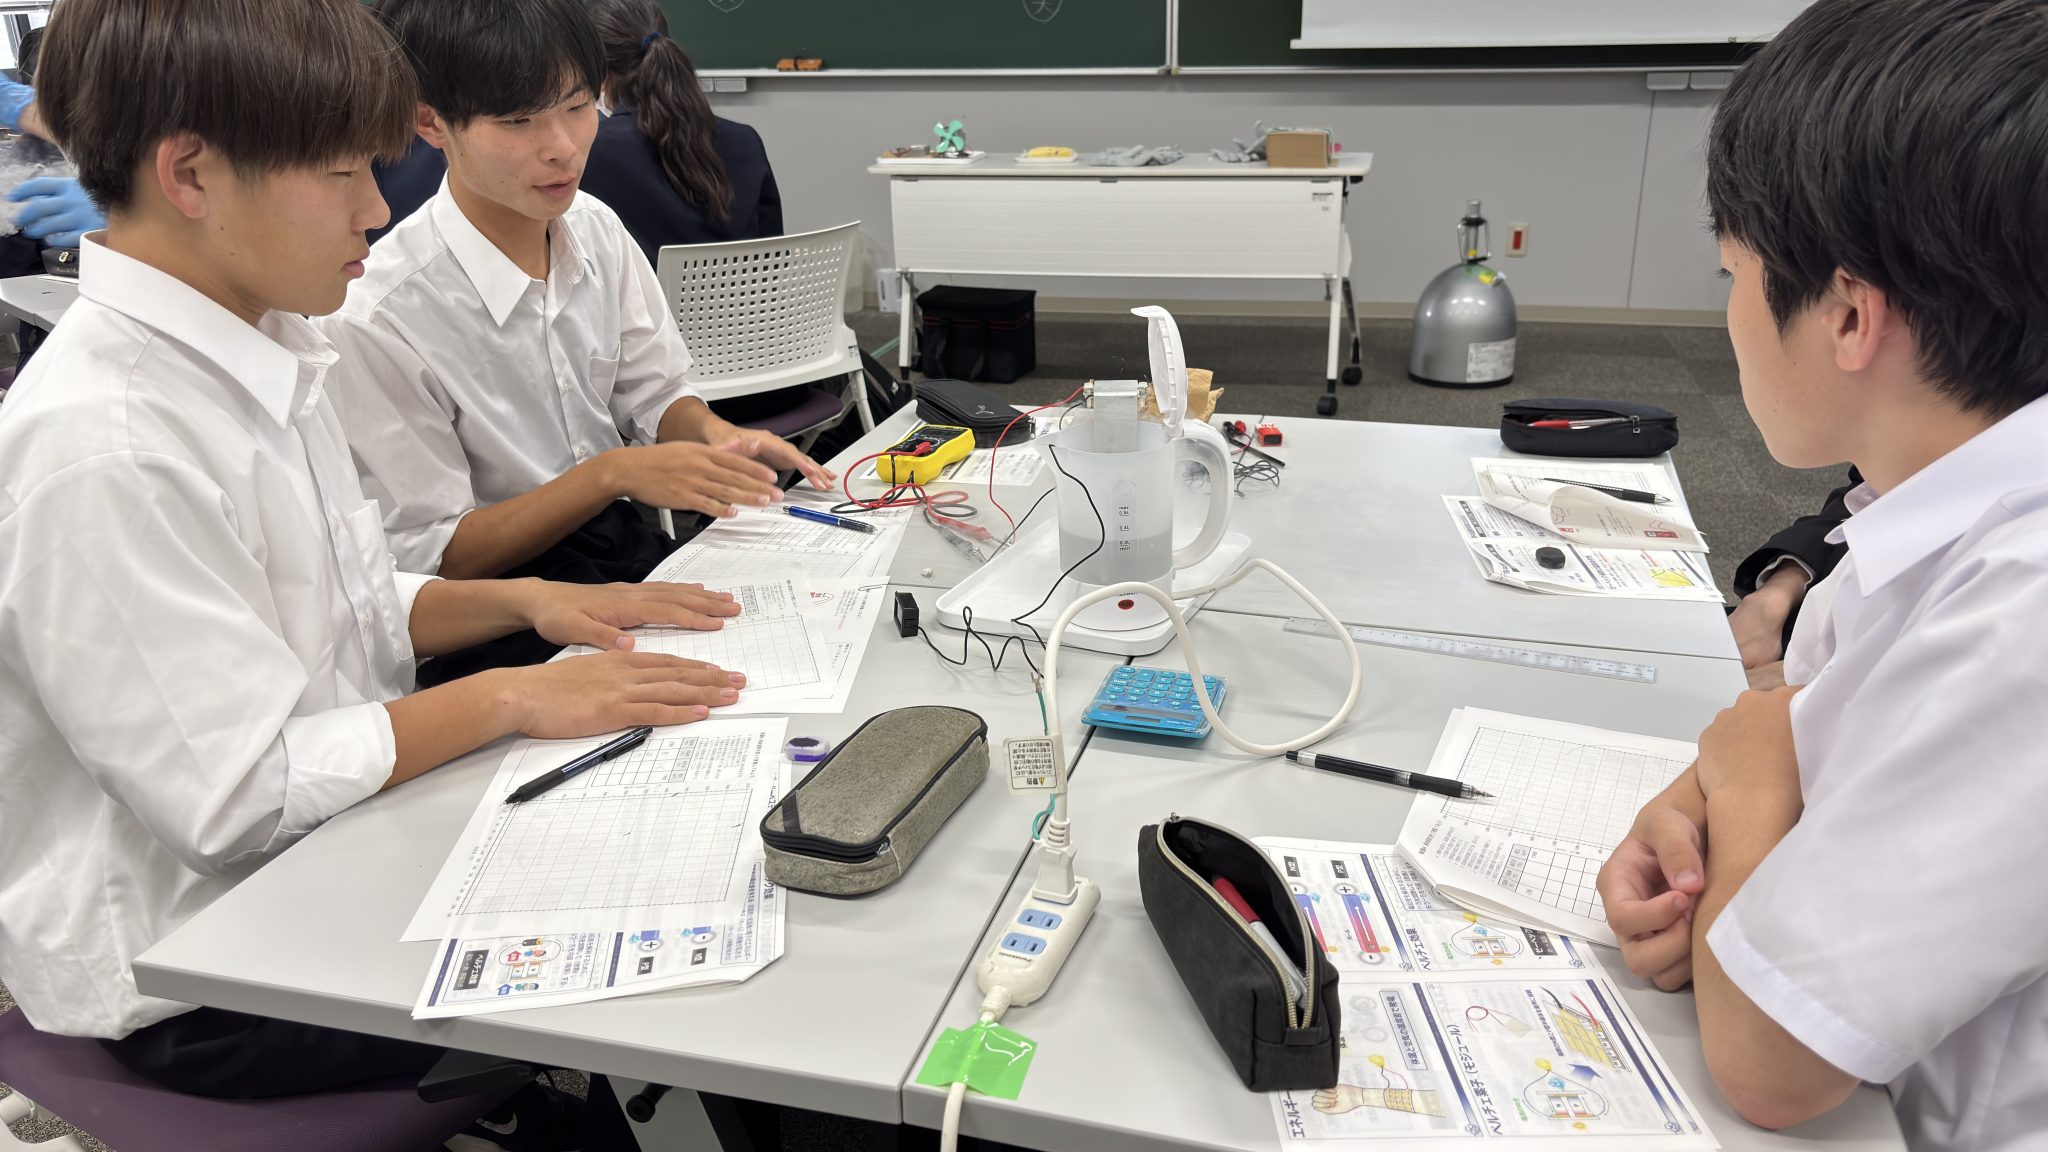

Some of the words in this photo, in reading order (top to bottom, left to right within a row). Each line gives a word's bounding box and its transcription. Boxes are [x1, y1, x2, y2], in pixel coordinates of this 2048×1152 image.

[1026, 777, 1038, 785] 警告
[1405, 927, 1432, 971] ペルチェ効果
